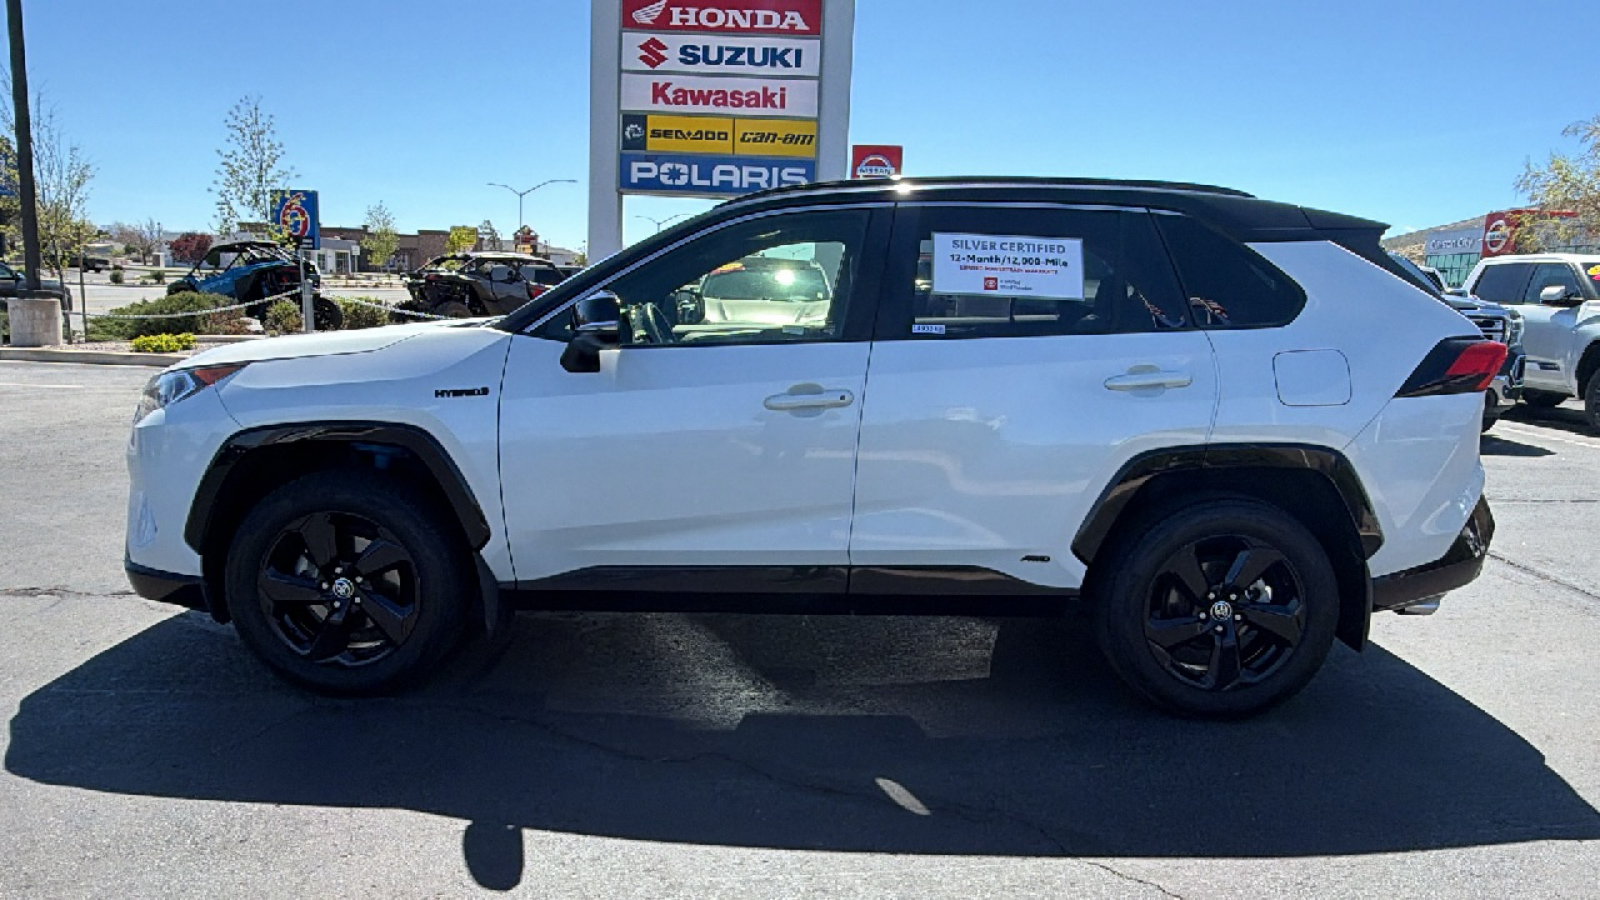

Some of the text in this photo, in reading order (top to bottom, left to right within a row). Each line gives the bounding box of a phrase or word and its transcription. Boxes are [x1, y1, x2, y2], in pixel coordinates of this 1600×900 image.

[669, 7, 810, 31] HONDA
[679, 44, 803, 68] SUZUKI
[652, 82, 786, 109] Kawasaki
[630, 161, 808, 189] POLARIS
[280, 192, 310, 237] 6
[952, 239, 1066, 254] SILVER CERTIFIED
[1457, 237, 1474, 248] City
